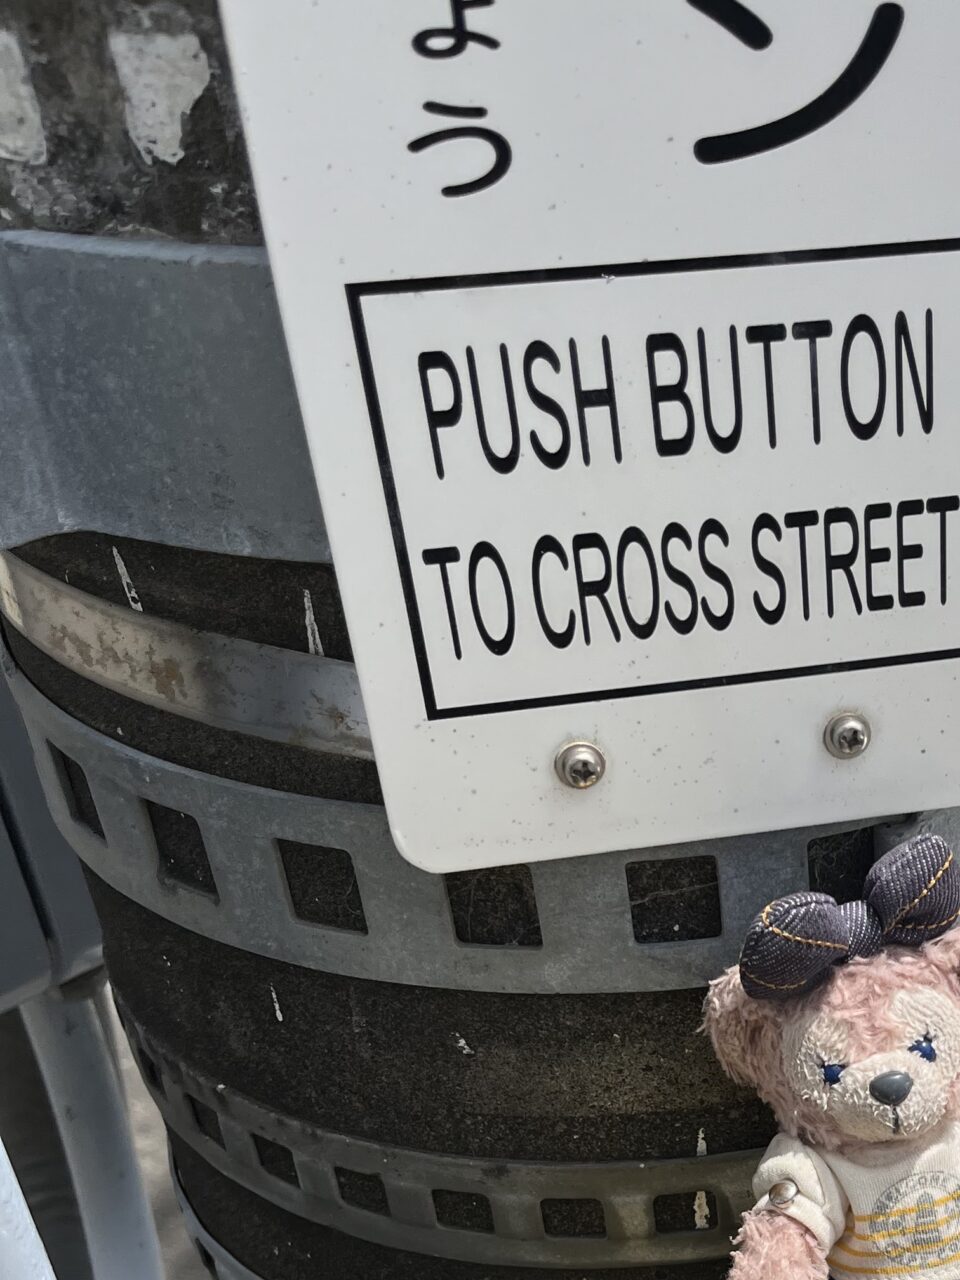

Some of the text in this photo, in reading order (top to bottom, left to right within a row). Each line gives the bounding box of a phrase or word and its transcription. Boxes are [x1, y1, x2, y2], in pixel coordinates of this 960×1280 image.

[417, 308, 934, 480] PUSH BUTTON
[421, 495, 960, 660] TO CROSS STREET
